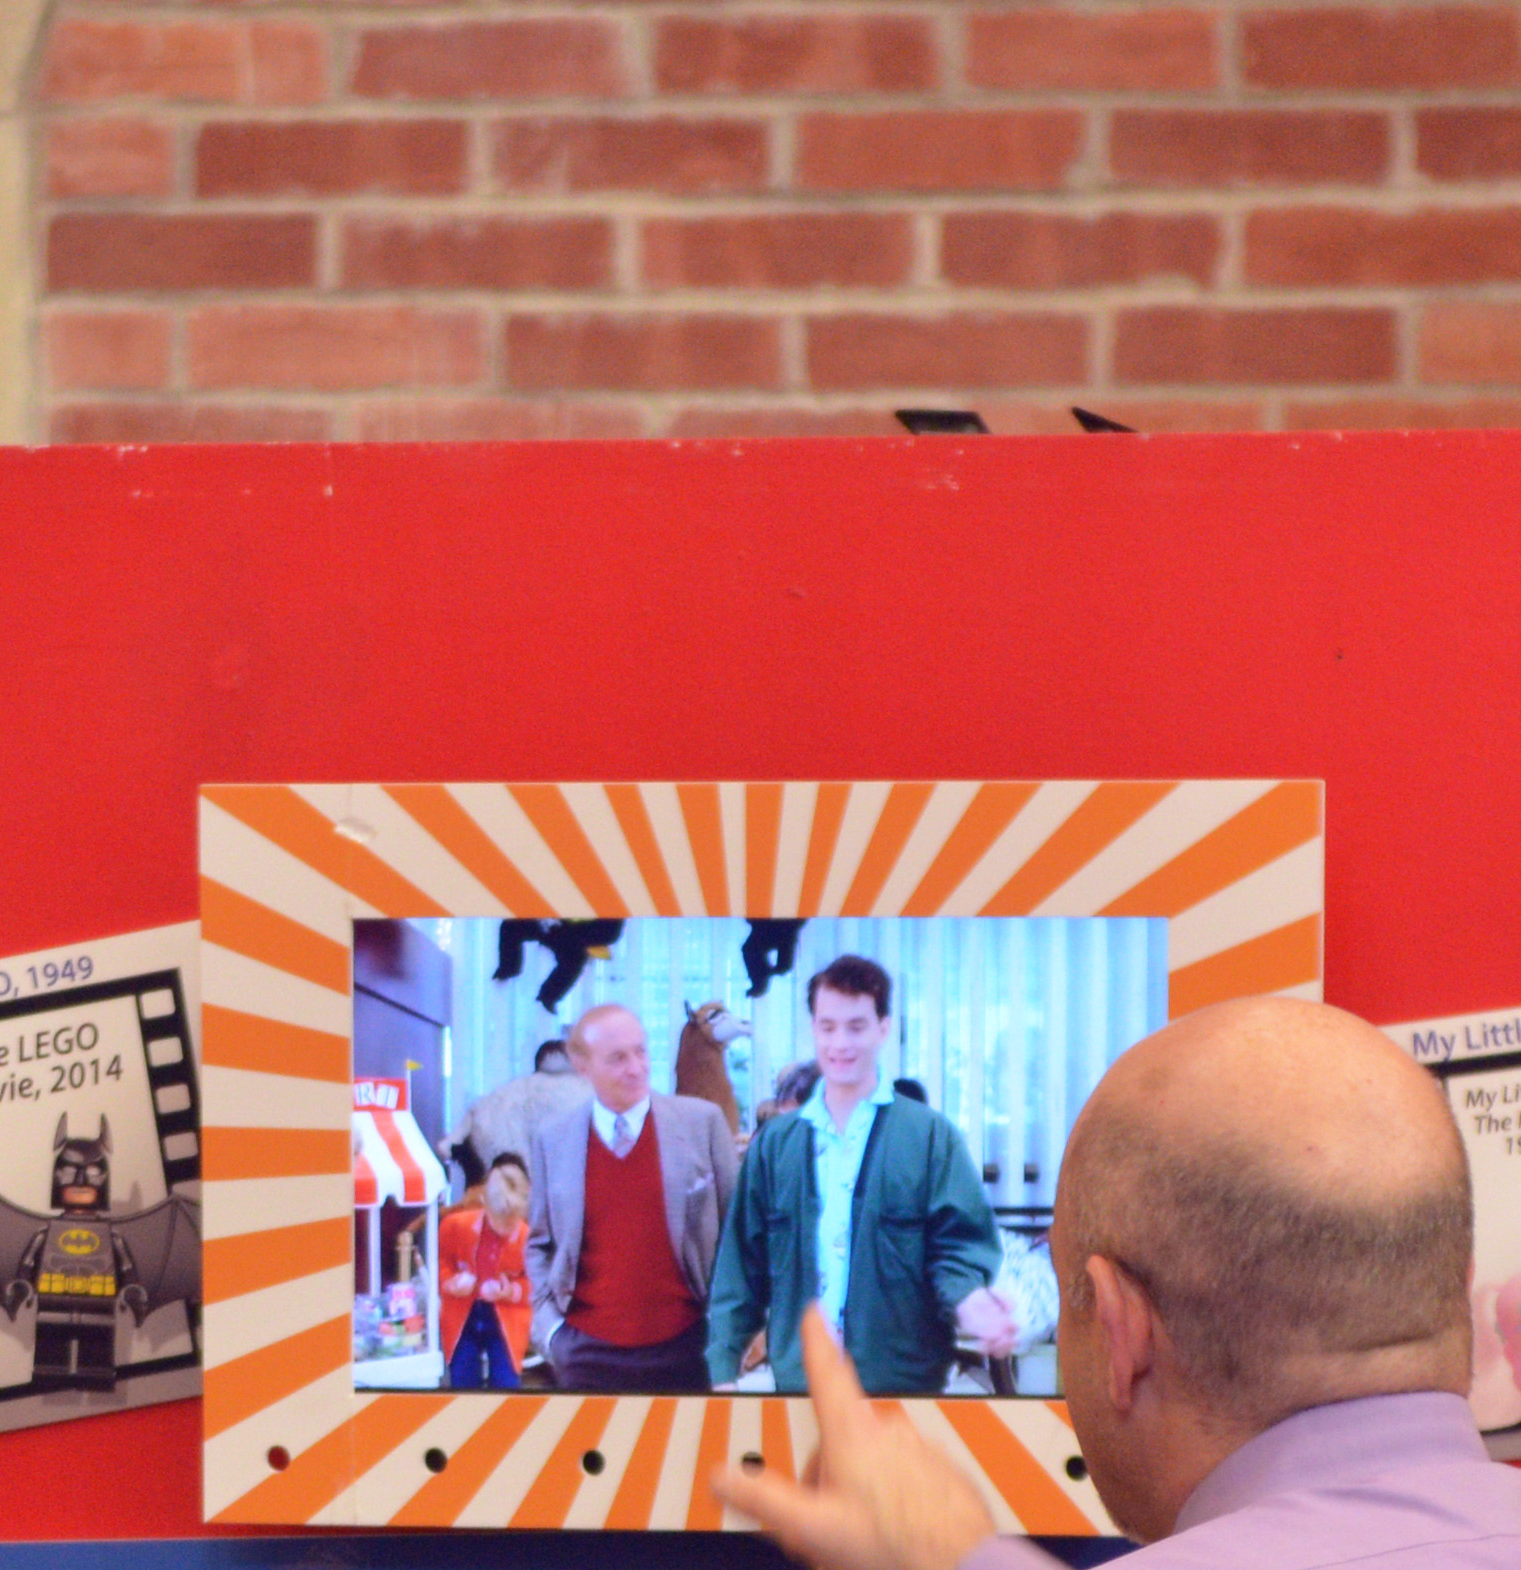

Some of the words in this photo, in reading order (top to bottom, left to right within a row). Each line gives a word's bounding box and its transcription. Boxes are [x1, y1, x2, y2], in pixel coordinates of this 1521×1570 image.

[27, 955, 94, 992] 1949
[18, 1022, 100, 1062] LEGO
[1412, 1031, 1456, 1062] My
[50, 1055, 124, 1093] 2014
[1466, 1089, 1497, 1112] My
[1474, 1114, 1512, 1135] The
